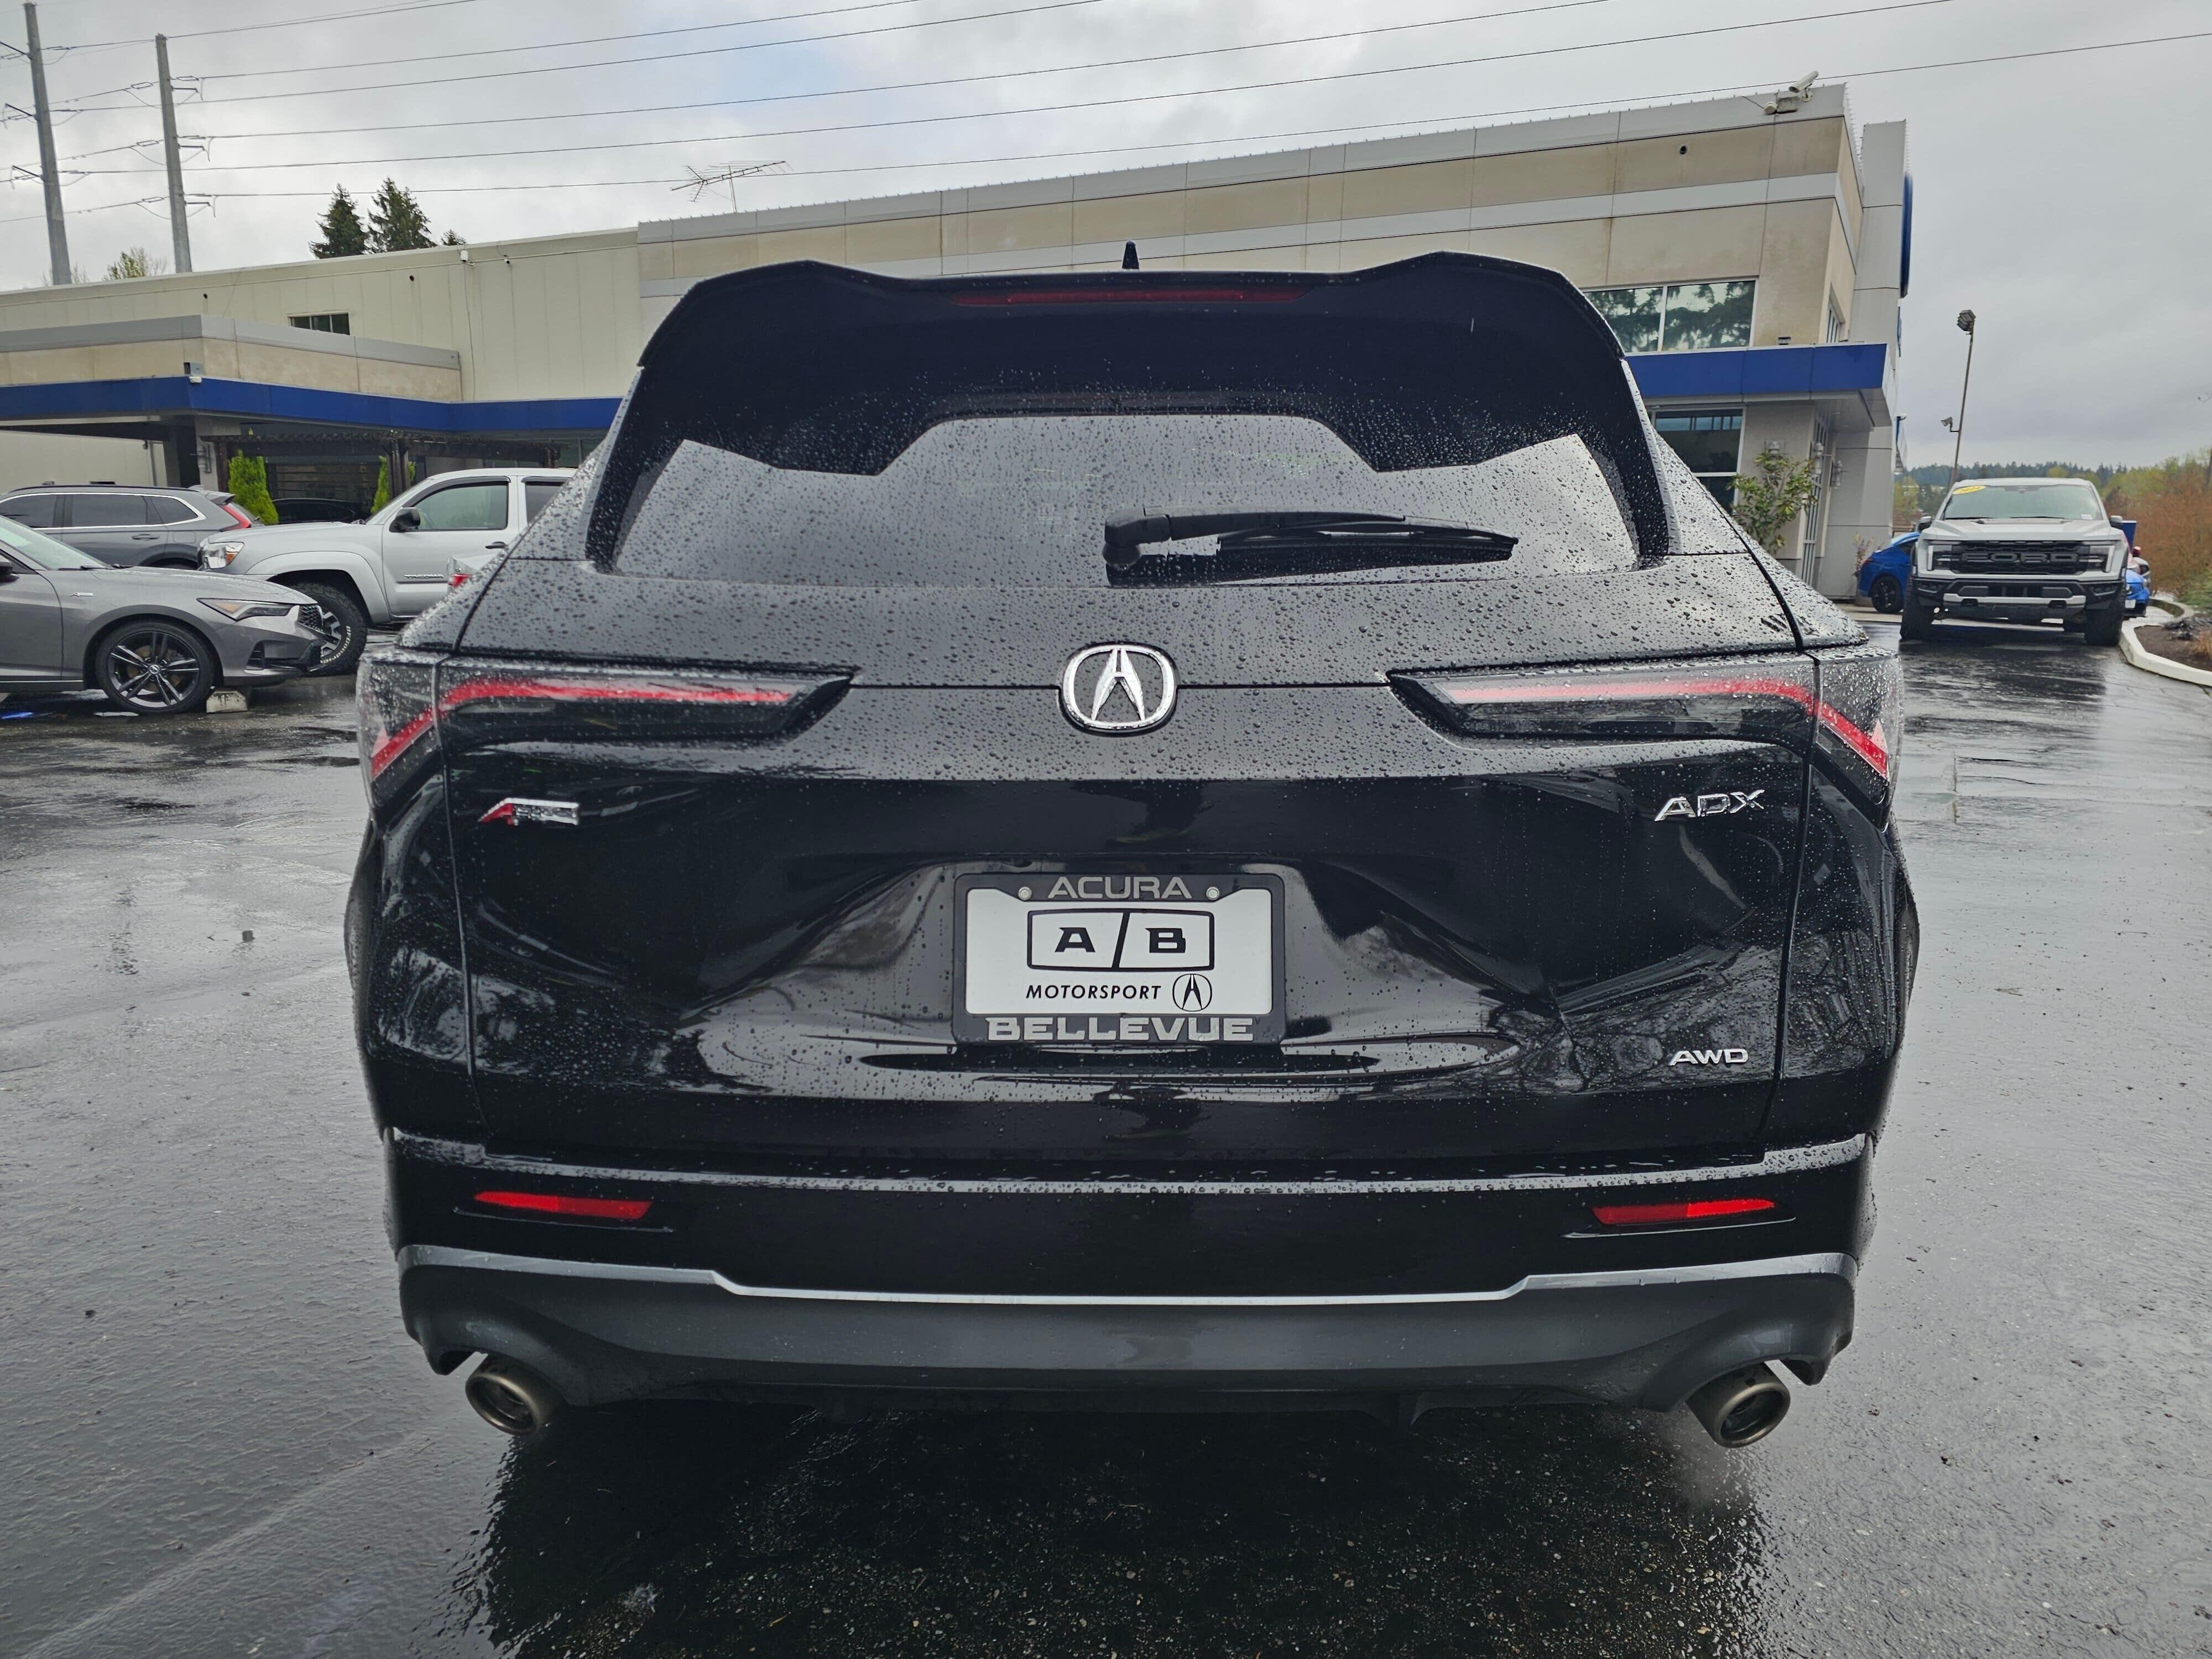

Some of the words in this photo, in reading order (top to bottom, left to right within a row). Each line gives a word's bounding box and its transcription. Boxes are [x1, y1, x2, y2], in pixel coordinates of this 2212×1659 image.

[1962, 552, 2079, 563] FORD
[1654, 789, 1765, 822] ADX
[1047, 876, 1192, 899] ACURA
[1055, 927, 1096, 953] A
[1145, 927, 1186, 953] B
[1026, 984, 1162, 1000] MOTORSPORT
[985, 1017, 1254, 1041] BELLEVUE
[1668, 1048, 1749, 1066] AWD
